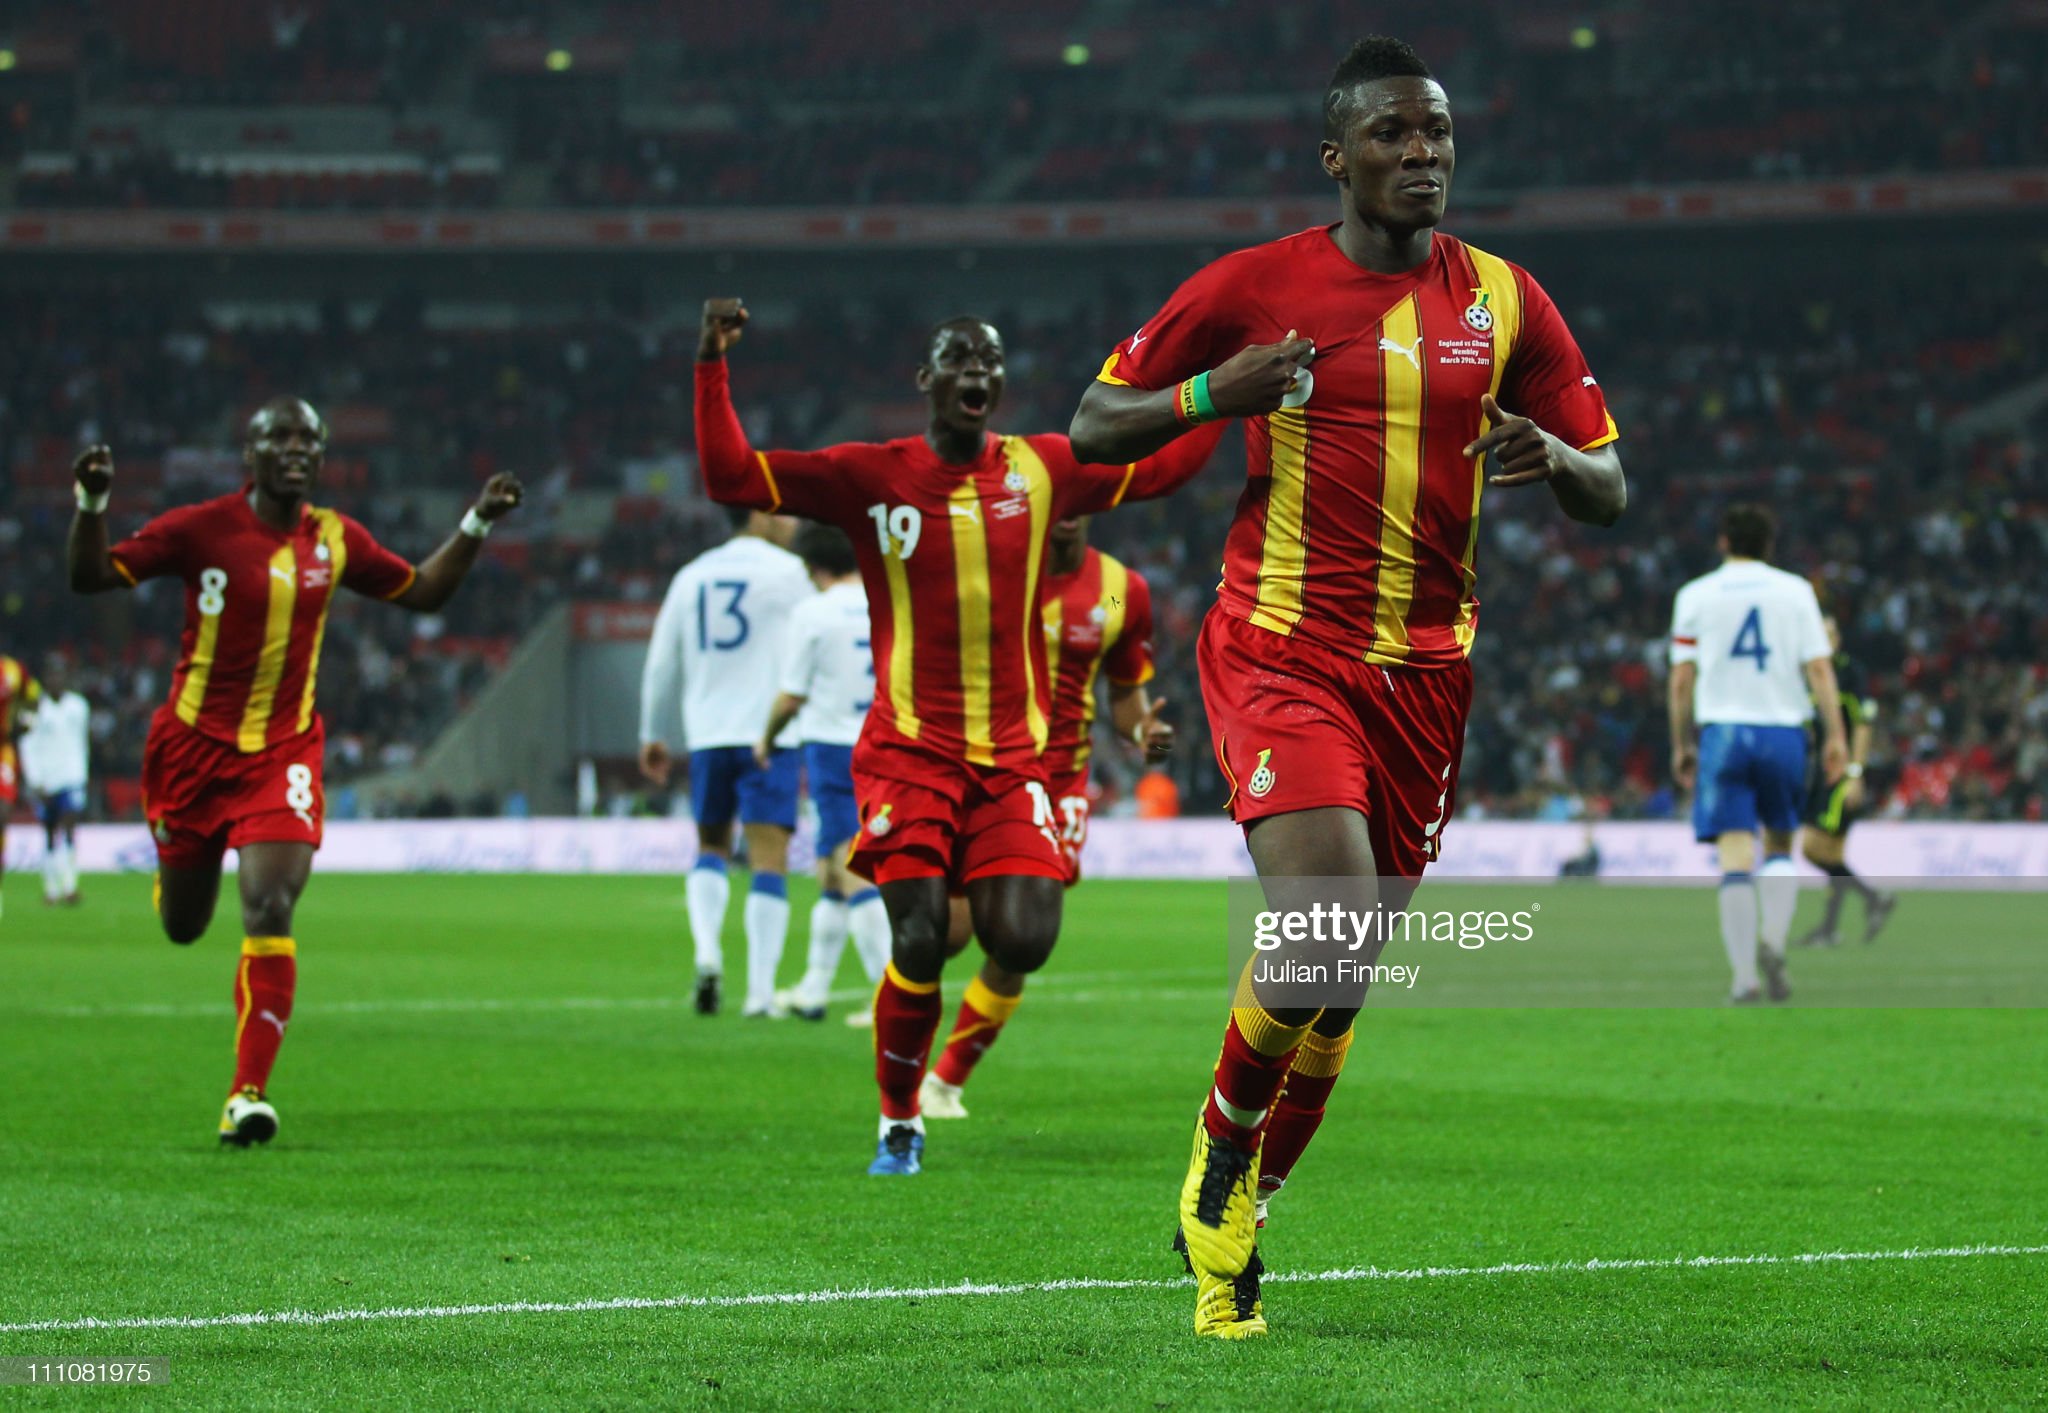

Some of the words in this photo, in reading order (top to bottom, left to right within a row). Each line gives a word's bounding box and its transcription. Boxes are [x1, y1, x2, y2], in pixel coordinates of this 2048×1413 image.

[1438, 340, 1463, 348] England
[1452, 348, 1479, 357] Wembley
[867, 502, 922, 560] 19
[198, 567, 228, 616] 8
[698, 580, 750, 652] 13
[1730, 605, 1770, 672] 4
[286, 763, 313, 811] 8
